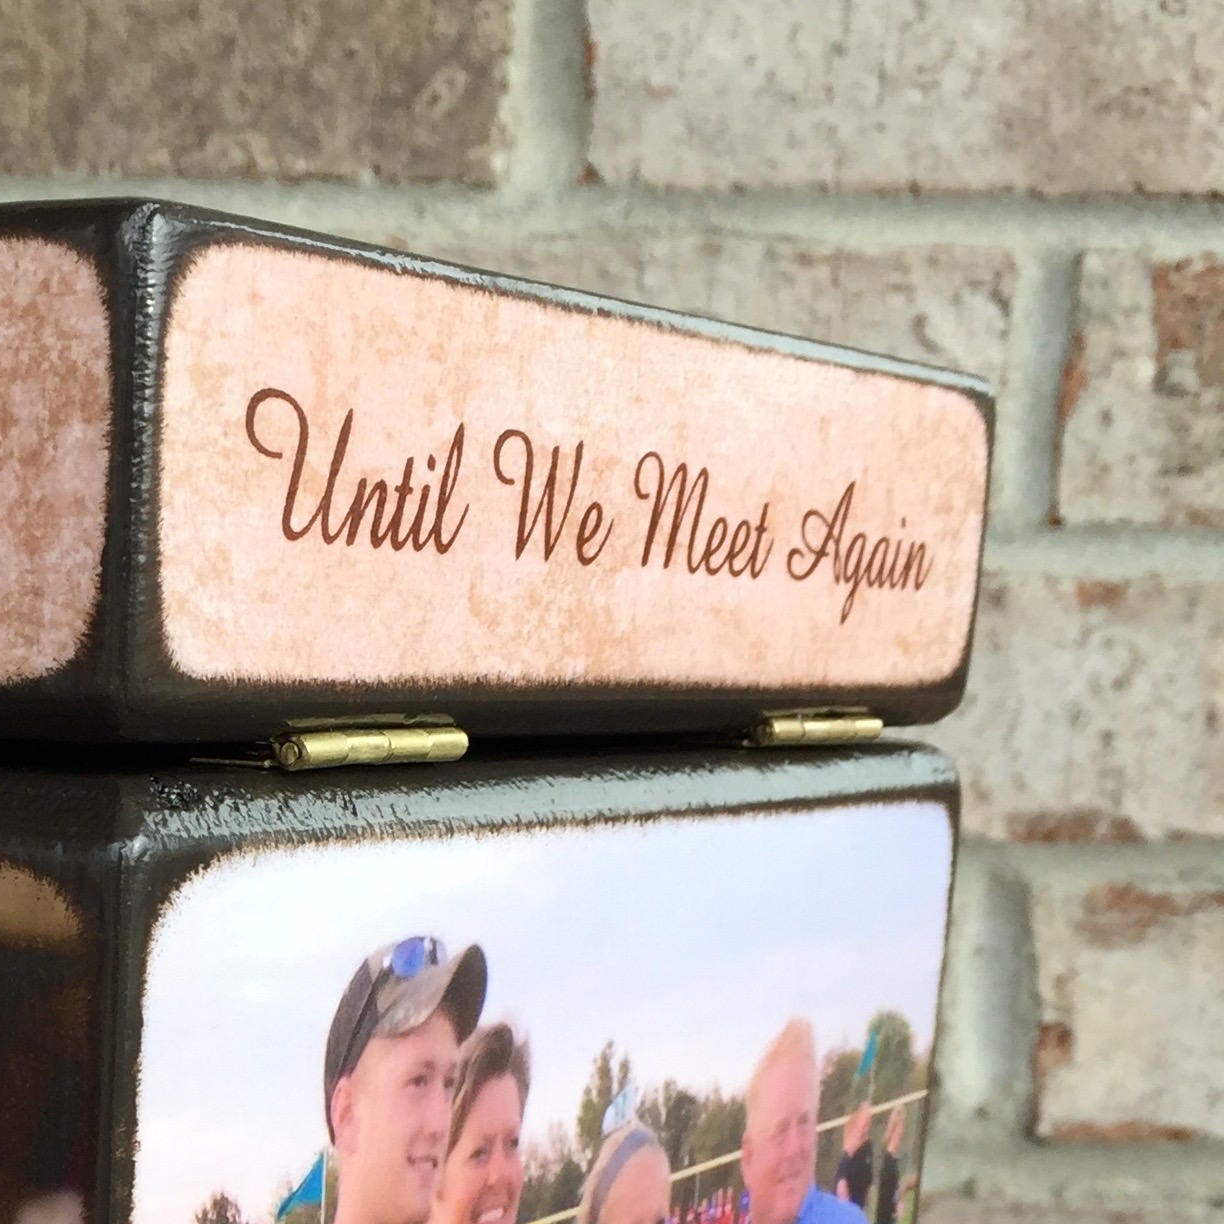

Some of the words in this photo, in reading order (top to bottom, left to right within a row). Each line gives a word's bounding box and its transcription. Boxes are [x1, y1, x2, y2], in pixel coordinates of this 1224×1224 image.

[245, 387, 470, 555] Until
[493, 428, 615, 567] We
[633, 450, 775, 580] Meet
[786, 480, 934, 626] Again
